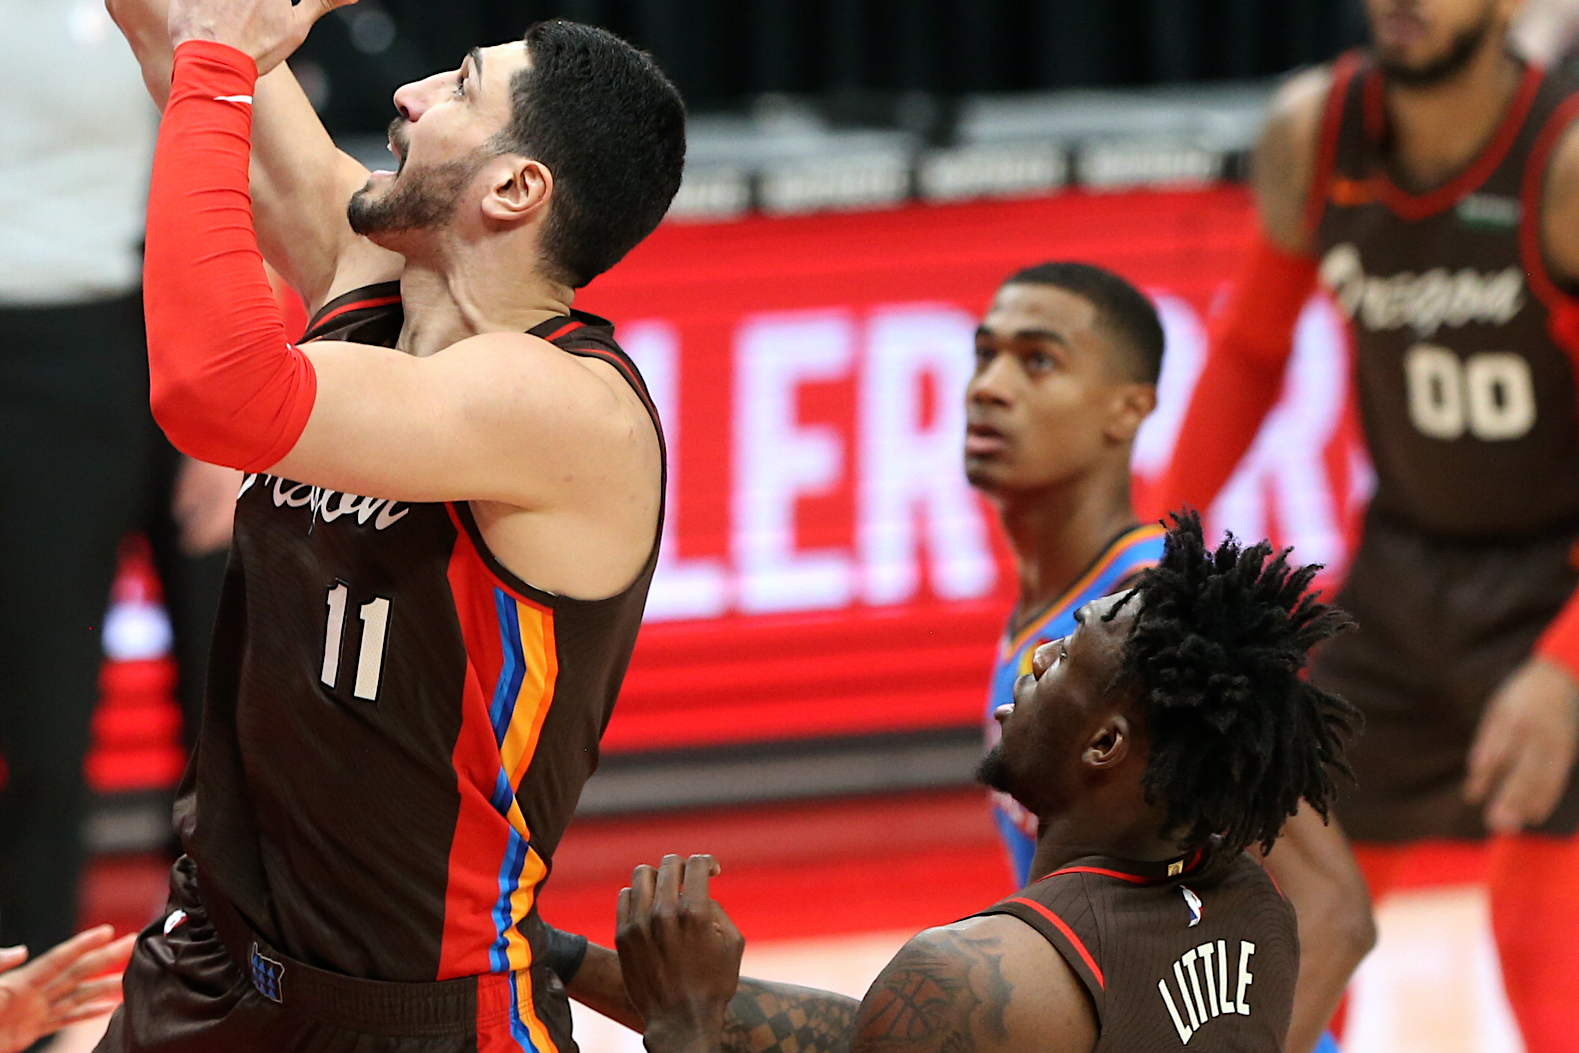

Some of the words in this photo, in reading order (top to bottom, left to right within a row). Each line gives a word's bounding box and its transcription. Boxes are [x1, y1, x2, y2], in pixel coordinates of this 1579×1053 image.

[1404, 342, 1538, 442] 00
[320, 579, 393, 702] 11
[1157, 939, 1256, 1045] LITTLE
